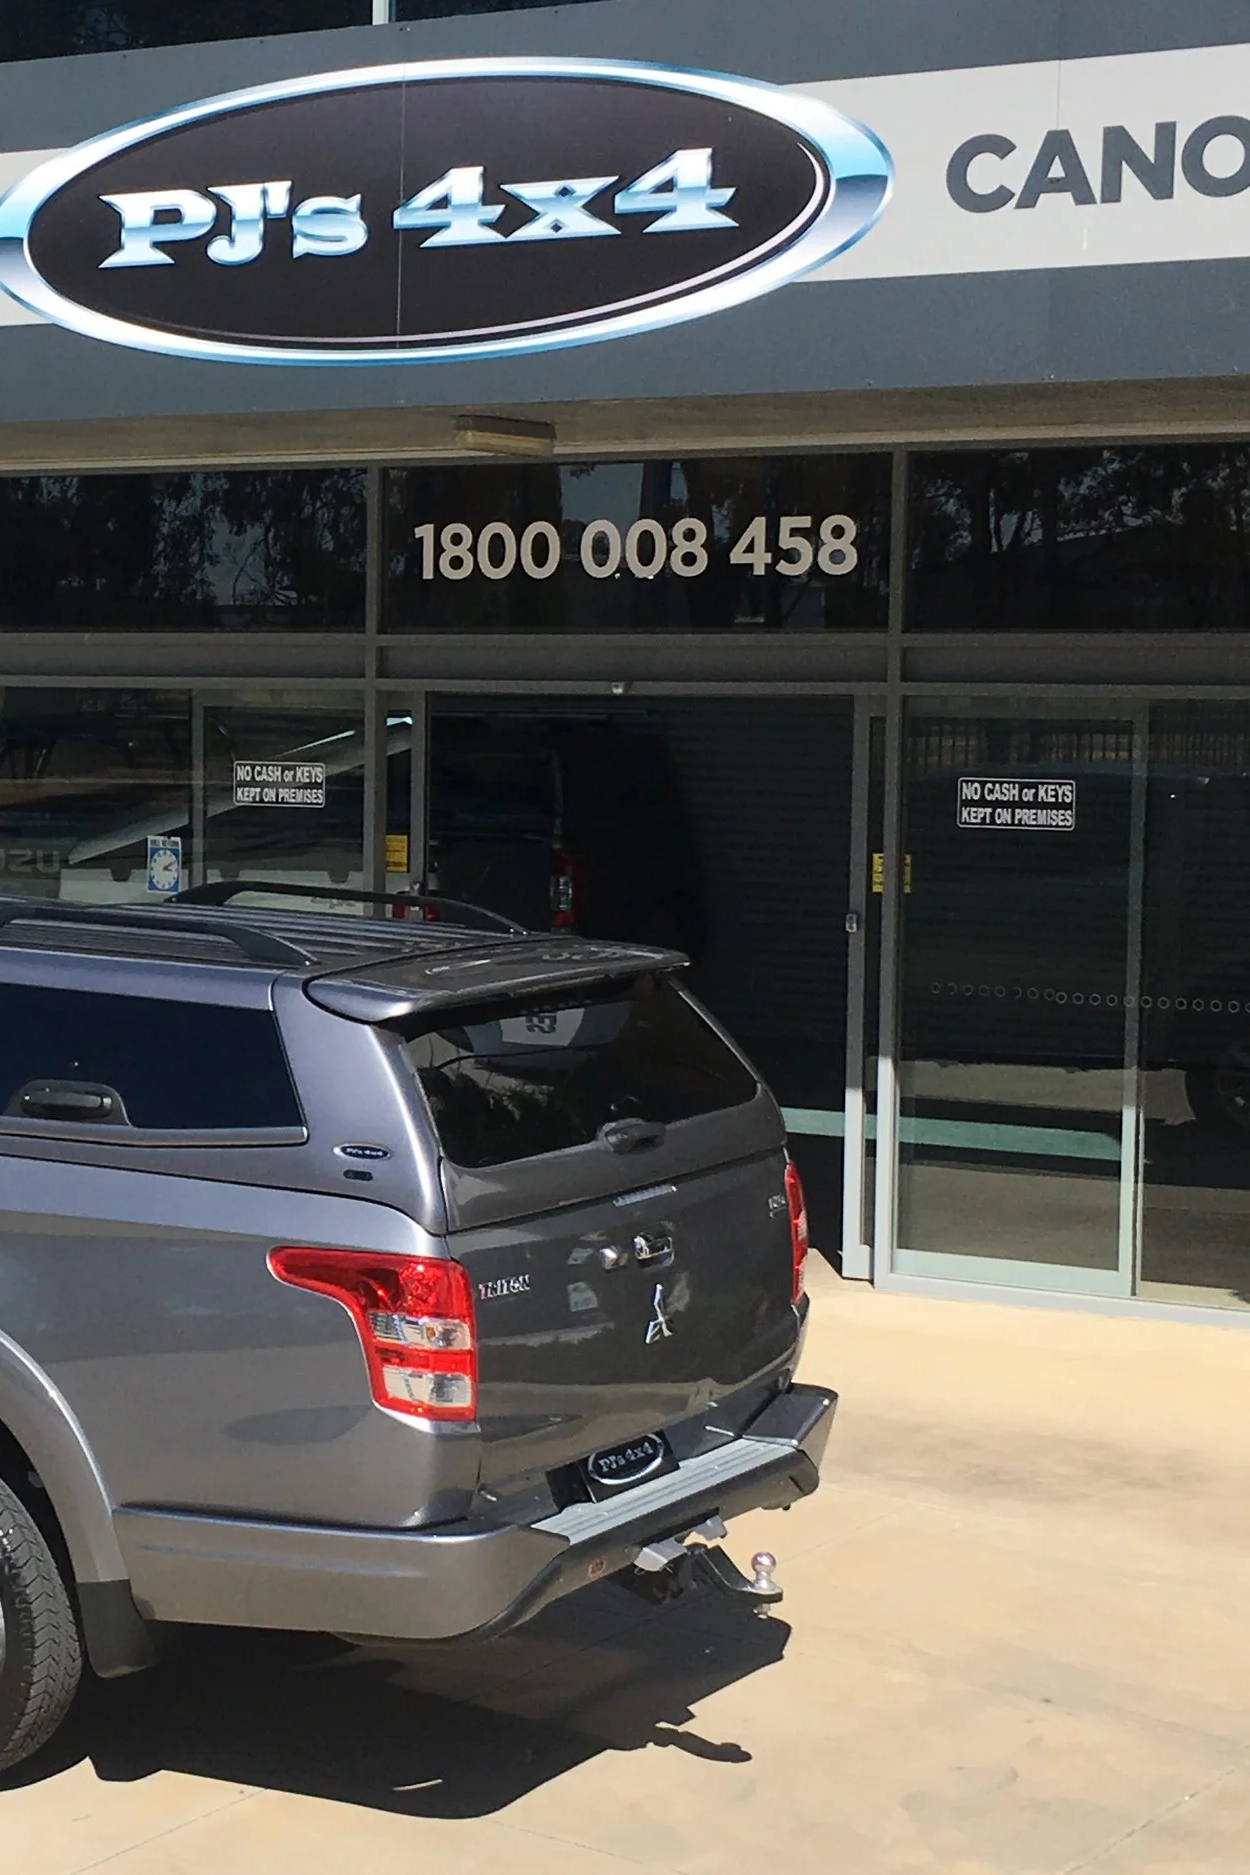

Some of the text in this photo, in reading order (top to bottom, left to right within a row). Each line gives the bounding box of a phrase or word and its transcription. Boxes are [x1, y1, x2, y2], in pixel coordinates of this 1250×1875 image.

[945, 115, 1250, 213] CANO
[98, 147, 740, 270] PJ's 4x4
[414, 514, 858, 580] 1800 008 458
[236, 765, 323, 783] NO CASH or KEYS
[236, 787, 324, 804] KEPT ON PREMISES
[962, 782, 1072, 803] NO CASH or KEYS
[961, 806, 1073, 826] KEPT ON PREMISES
